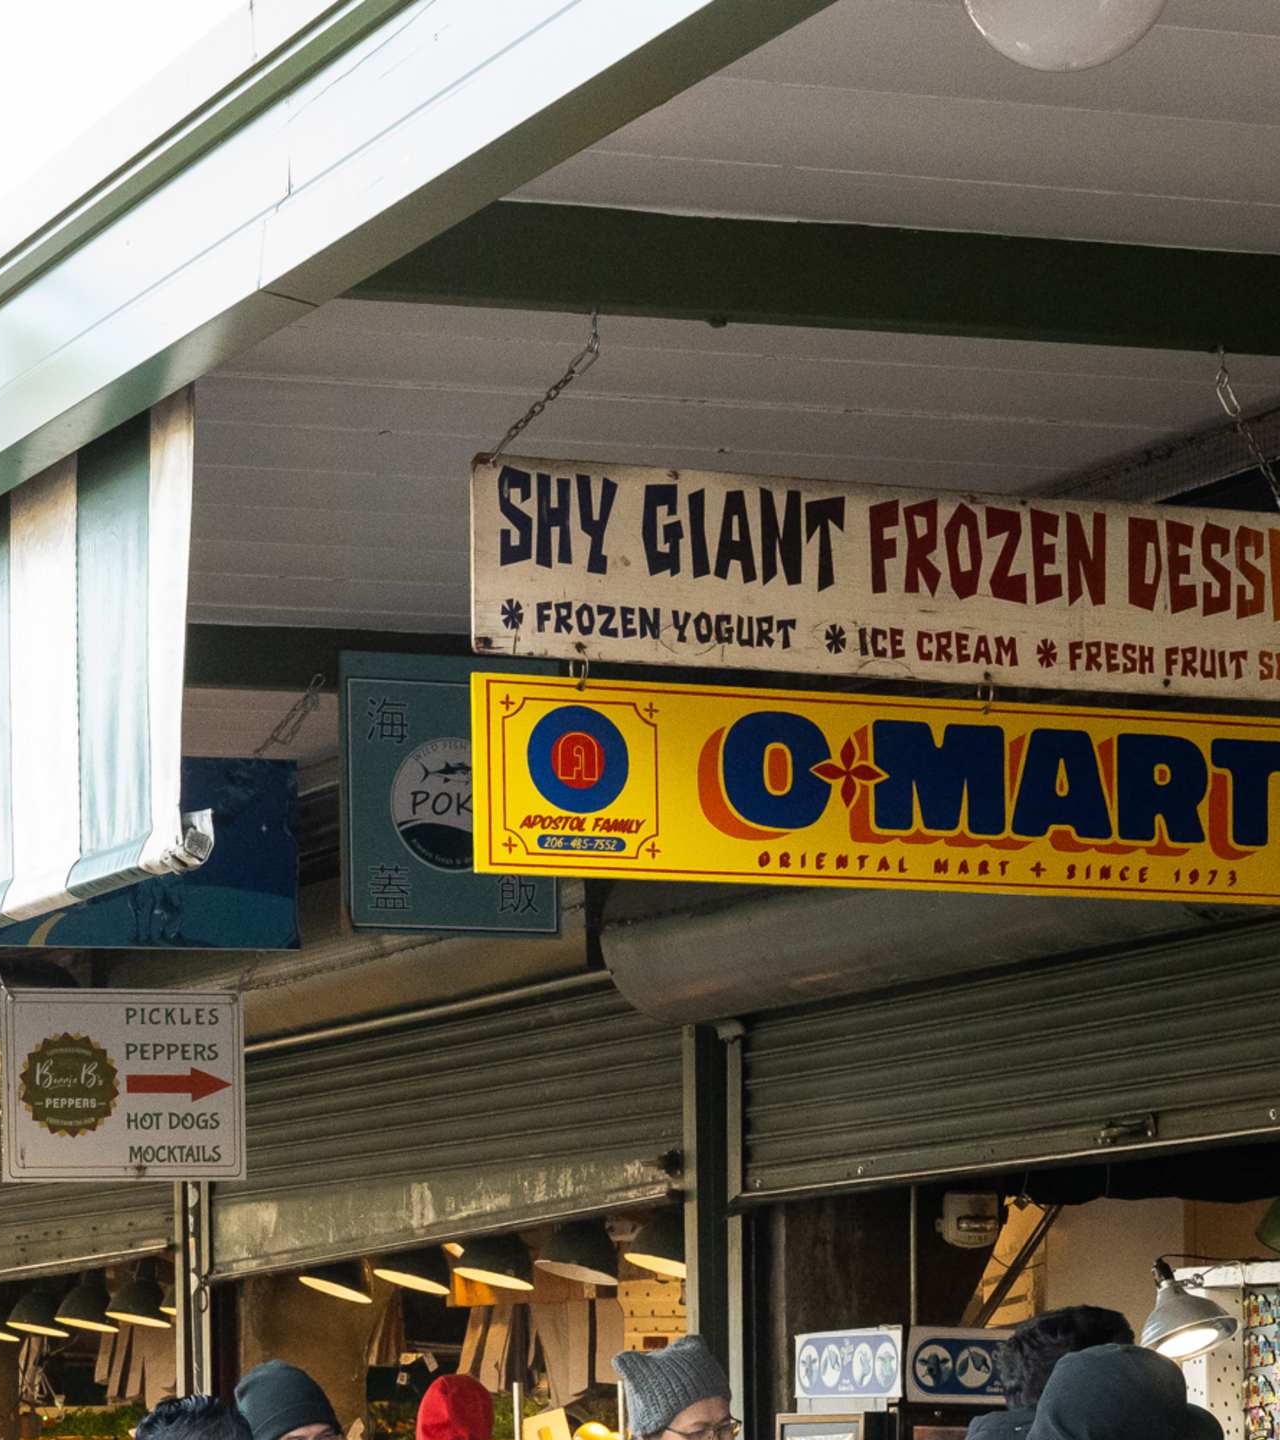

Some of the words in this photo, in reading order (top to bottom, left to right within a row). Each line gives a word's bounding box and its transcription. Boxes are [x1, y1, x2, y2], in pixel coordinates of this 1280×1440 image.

[497, 465, 618, 575] SHY
[641, 482, 846, 593] GIANT
[868, 497, 1107, 607] FROZEN
[535, 600, 661, 639] FROZEN
[671, 609, 797, 650] YOGURT
[858, 626, 907, 659] ICE
[915, 629, 1019, 668] CREAM
[1068, 640, 1155, 676] FRESH
[1164, 645, 1249, 680] FRUIT
[367, 698, 409, 744] 海
[409, 789, 472, 817] POK
[519, 814, 588, 832] APOSTOL
[591, 816, 647, 835] FAMILY
[757, 850, 910, 876] ORIENTAL
[933, 855, 1010, 877] MART
[1065, 863, 1150, 885] SINCE
[1173, 867, 1239, 888] 1973
[369, 864, 411, 910] 蓋
[124, 1006, 221, 1026] PICKLES
[124, 1042, 220, 1062] PEPPERS
[45, 1097, 97, 1109] PEPPERS
[126, 1111, 164, 1131] HOT
[167, 1112, 221, 1131] DOGS
[128, 1144, 223, 1164] MOCKTAILS
